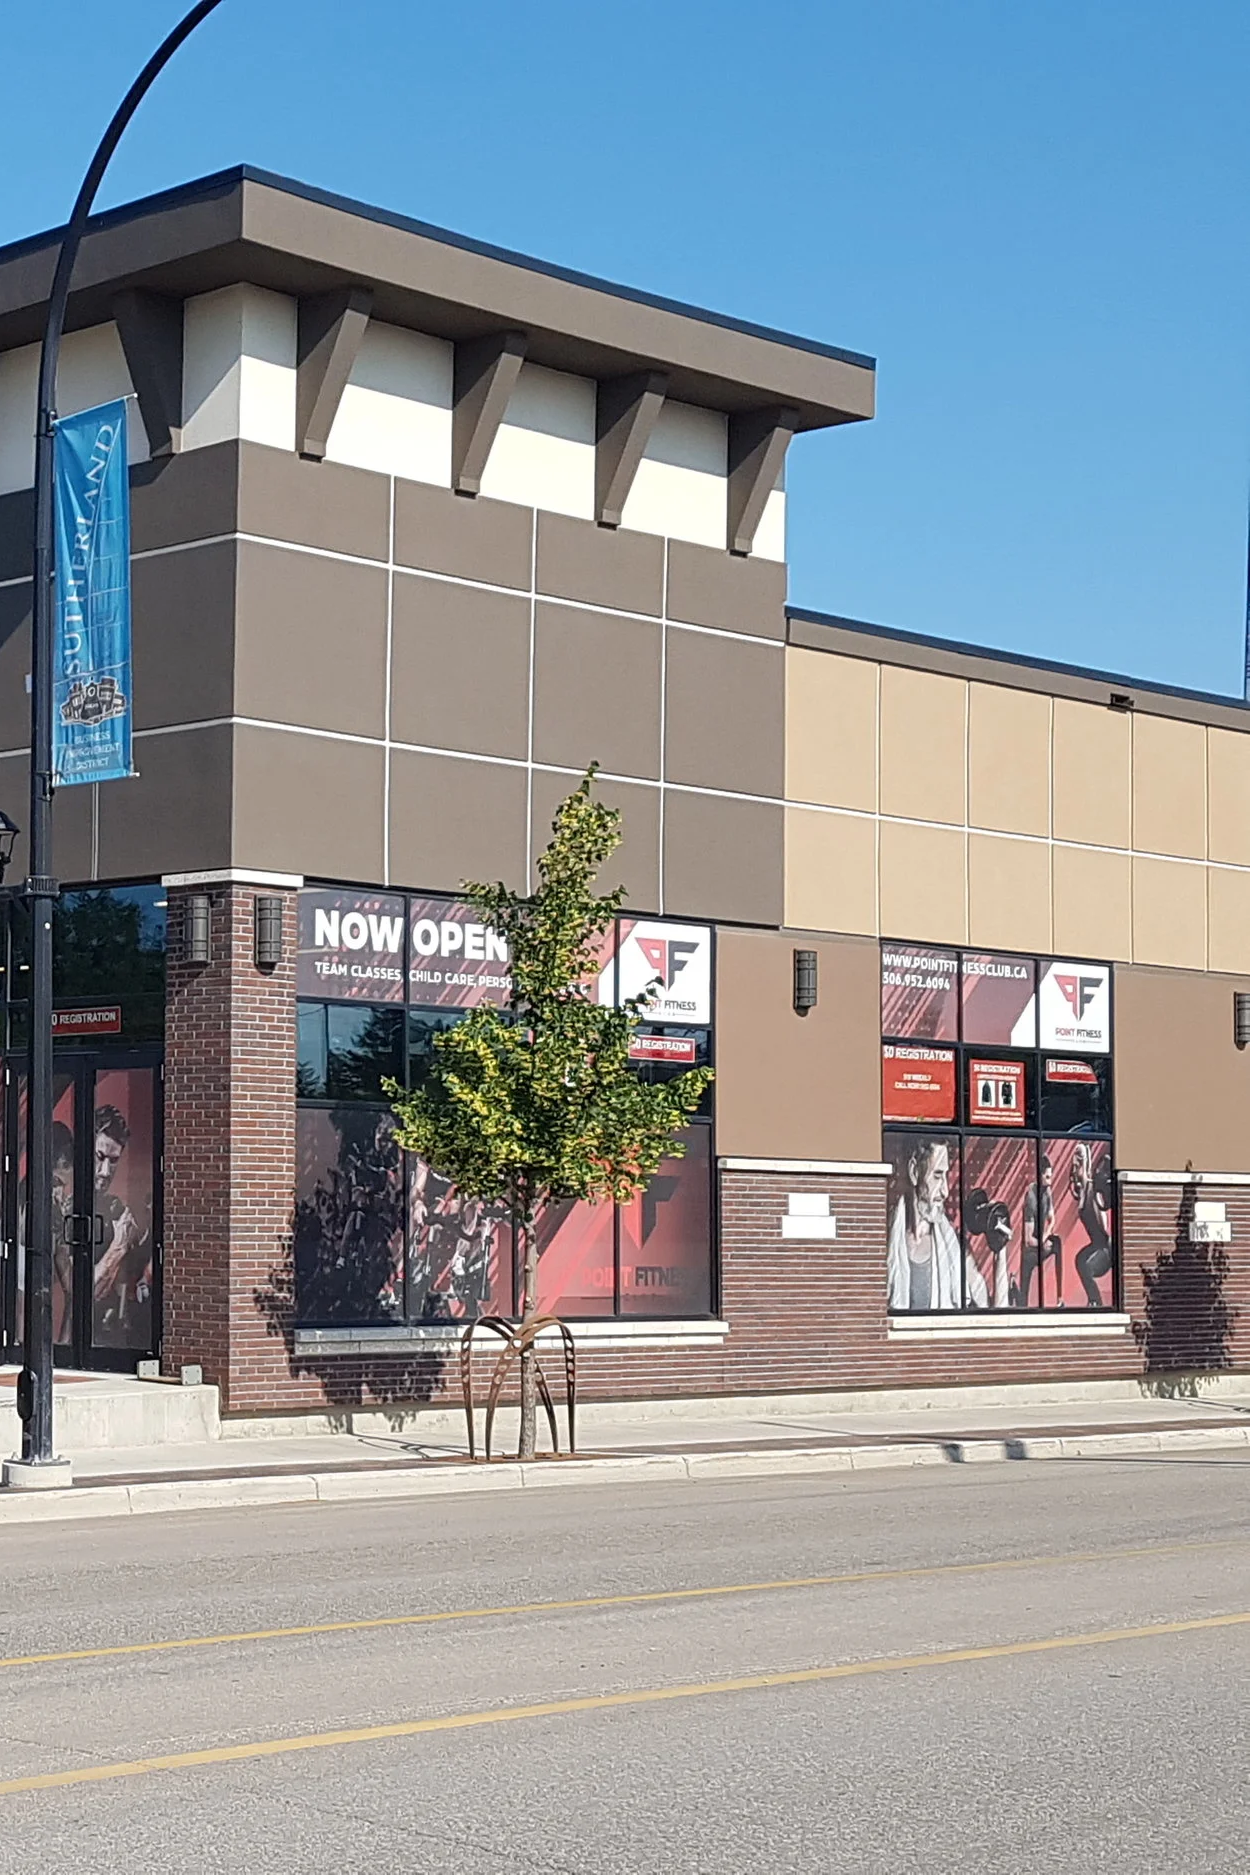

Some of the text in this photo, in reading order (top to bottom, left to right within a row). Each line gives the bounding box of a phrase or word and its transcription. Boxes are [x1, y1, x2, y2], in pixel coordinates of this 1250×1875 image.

[65, 423, 115, 676] SUTHERLAND
[315, 909, 508, 962] NOW OPEN
[315, 962, 348, 976] TEAM
[351, 965, 403, 982] CLASSES,
[409, 969, 442, 983] CHILD
[444, 972, 478, 988] CARE,
[478, 976, 513, 989] PERSO
[882, 971, 950, 990] 306.952.6094
[664, 1000, 696, 1011] FITNESS
[59, 1012, 116, 1025] REGISTRATION
[1055, 1027, 1102, 1039] POINT FITNESS
[895, 1047, 954, 1062] REGISTRATION
